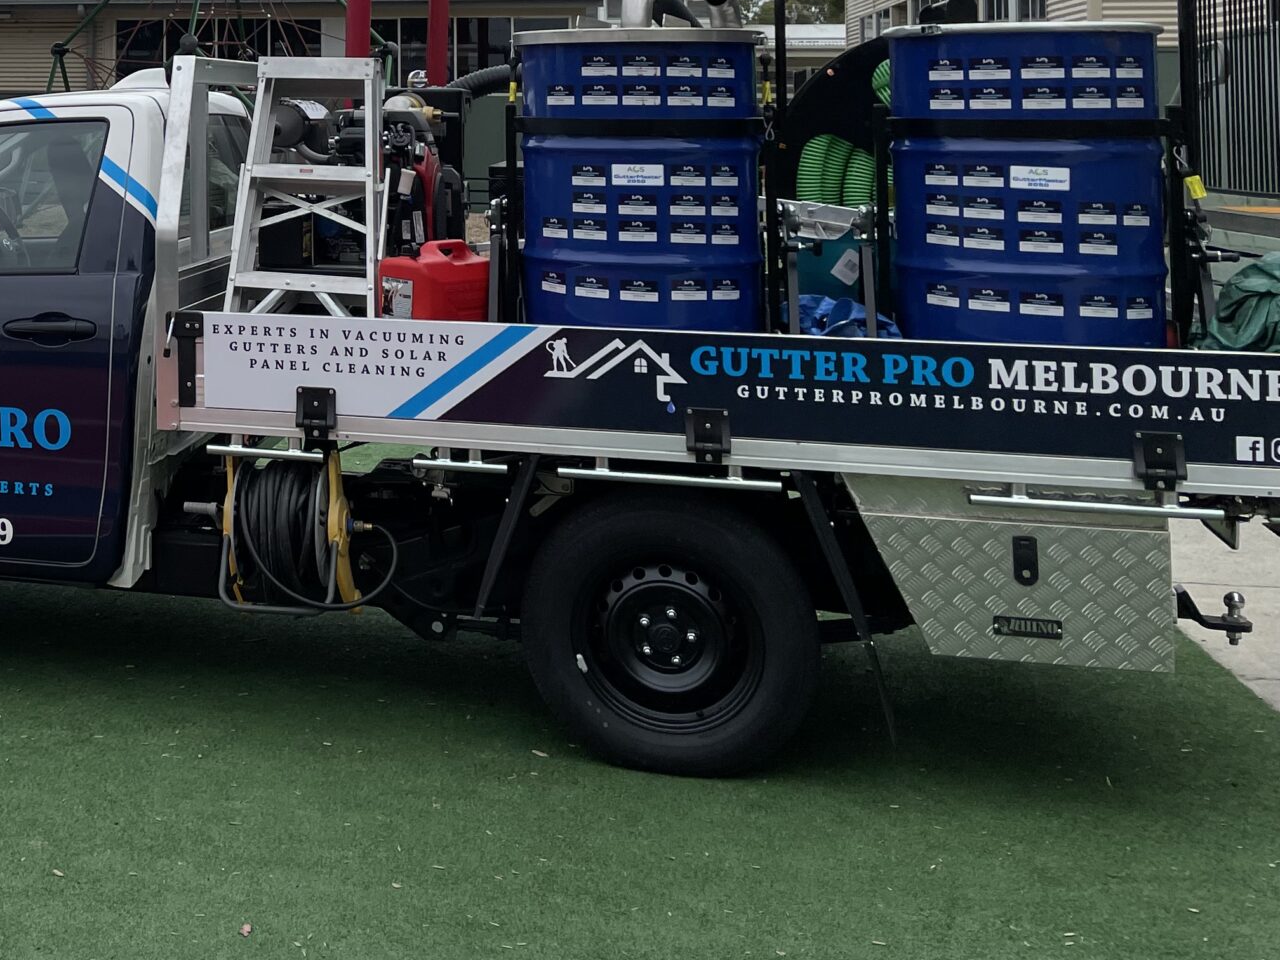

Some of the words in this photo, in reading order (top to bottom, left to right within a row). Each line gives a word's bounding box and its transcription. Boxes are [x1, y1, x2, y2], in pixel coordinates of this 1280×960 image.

[211, 323, 299, 339] EXPERTS
[309, 327, 330, 340] IN
[342, 329, 466, 347] VACUUMING
[228, 341, 318, 356] GUTTERS
[329, 346, 370, 358] AND
[381, 348, 448, 362] SOLAR
[249, 358, 310, 372] PANEL
[322, 361, 427, 378] CLEANING
[690, 345, 870, 383] GUTTER
[882, 353, 975, 388] PRO
[988, 358, 1280, 401] MELBOURNE
[737, 384, 1227, 423] GUTTERPROMELBOURNE.COM.AU
